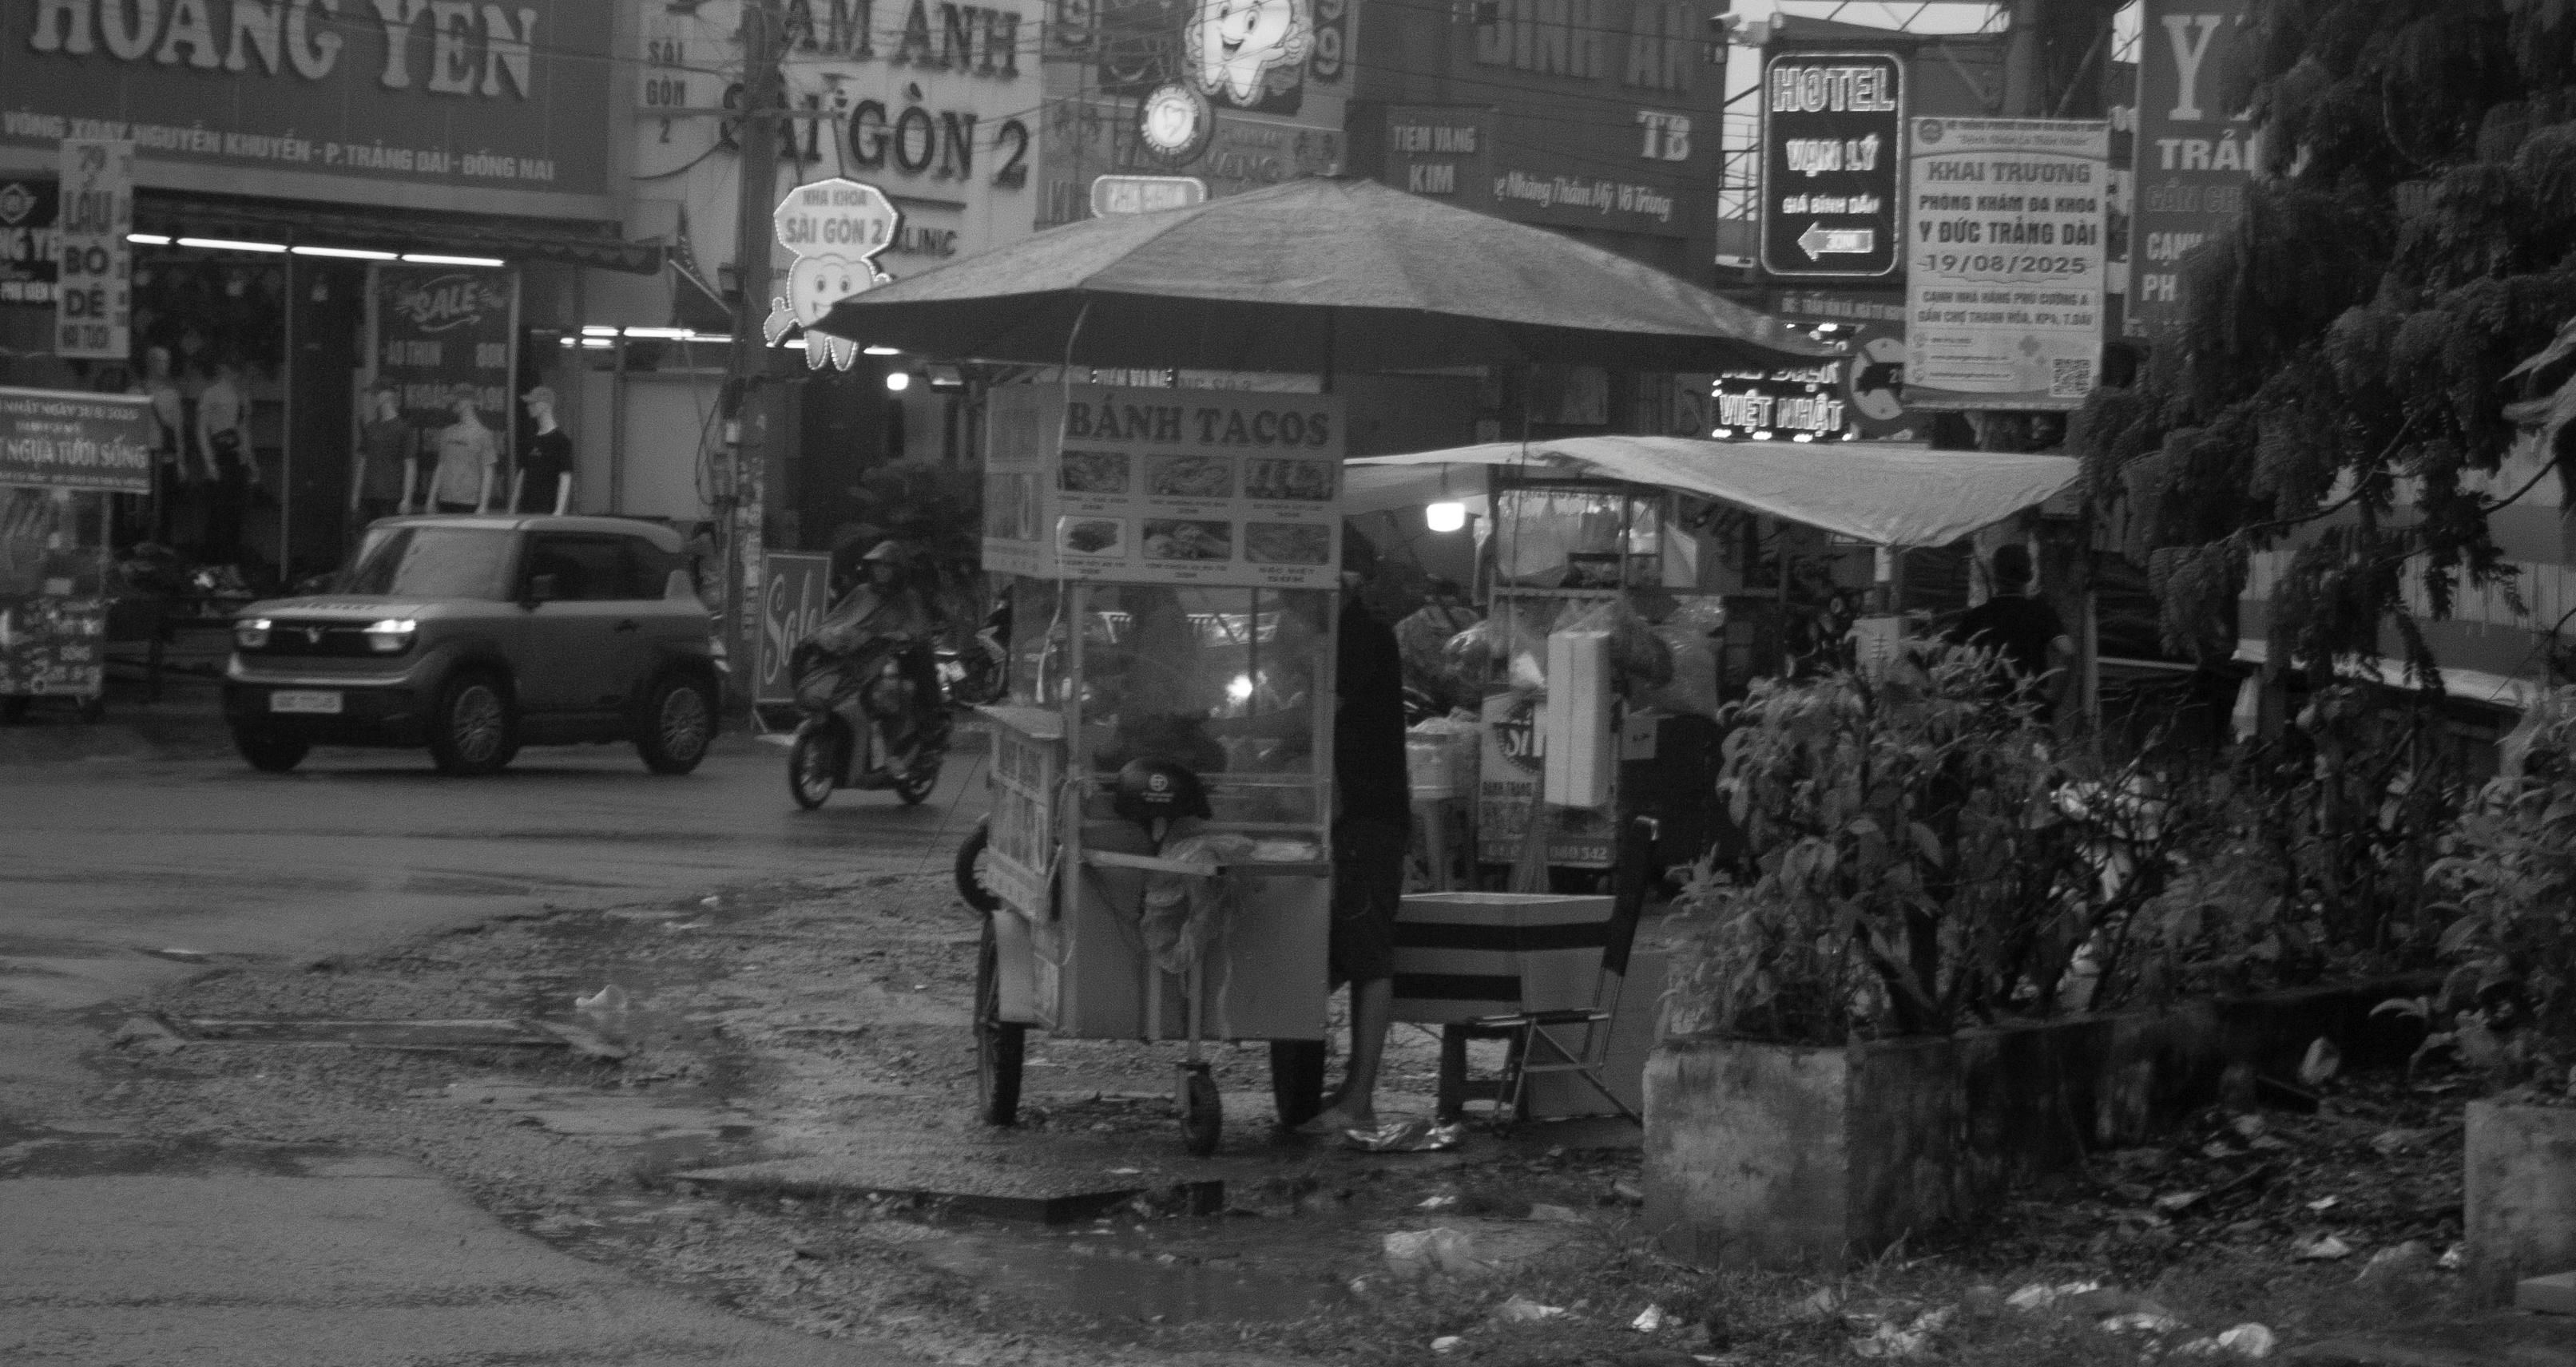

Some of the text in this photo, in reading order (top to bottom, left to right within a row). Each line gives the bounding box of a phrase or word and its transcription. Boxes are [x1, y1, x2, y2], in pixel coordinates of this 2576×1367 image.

[2160, 14, 2222, 121] Y
[1772, 66, 1896, 112] HOTEL
[848, 81, 978, 181] GÒN
[991, 119, 1030, 188] 2
[1636, 109, 1691, 161] TB
[518, 158, 554, 181] NAI
[1408, 164, 1455, 193] KIM
[1927, 161, 1985, 181] KHAI
[785, 211, 883, 244] SÀI GÒN 2
[1919, 220, 1932, 243] Y
[1988, 215, 2054, 245] TRẢNG
[2062, 218, 2096, 246] DÀI
[1924, 254, 2086, 274] 19/08/2025
[411, 282, 478, 323] SALE
[1066, 392, 1330, 448] BÁNH TACOS
[1719, 388, 1845, 438] VIỆT NHẬT
